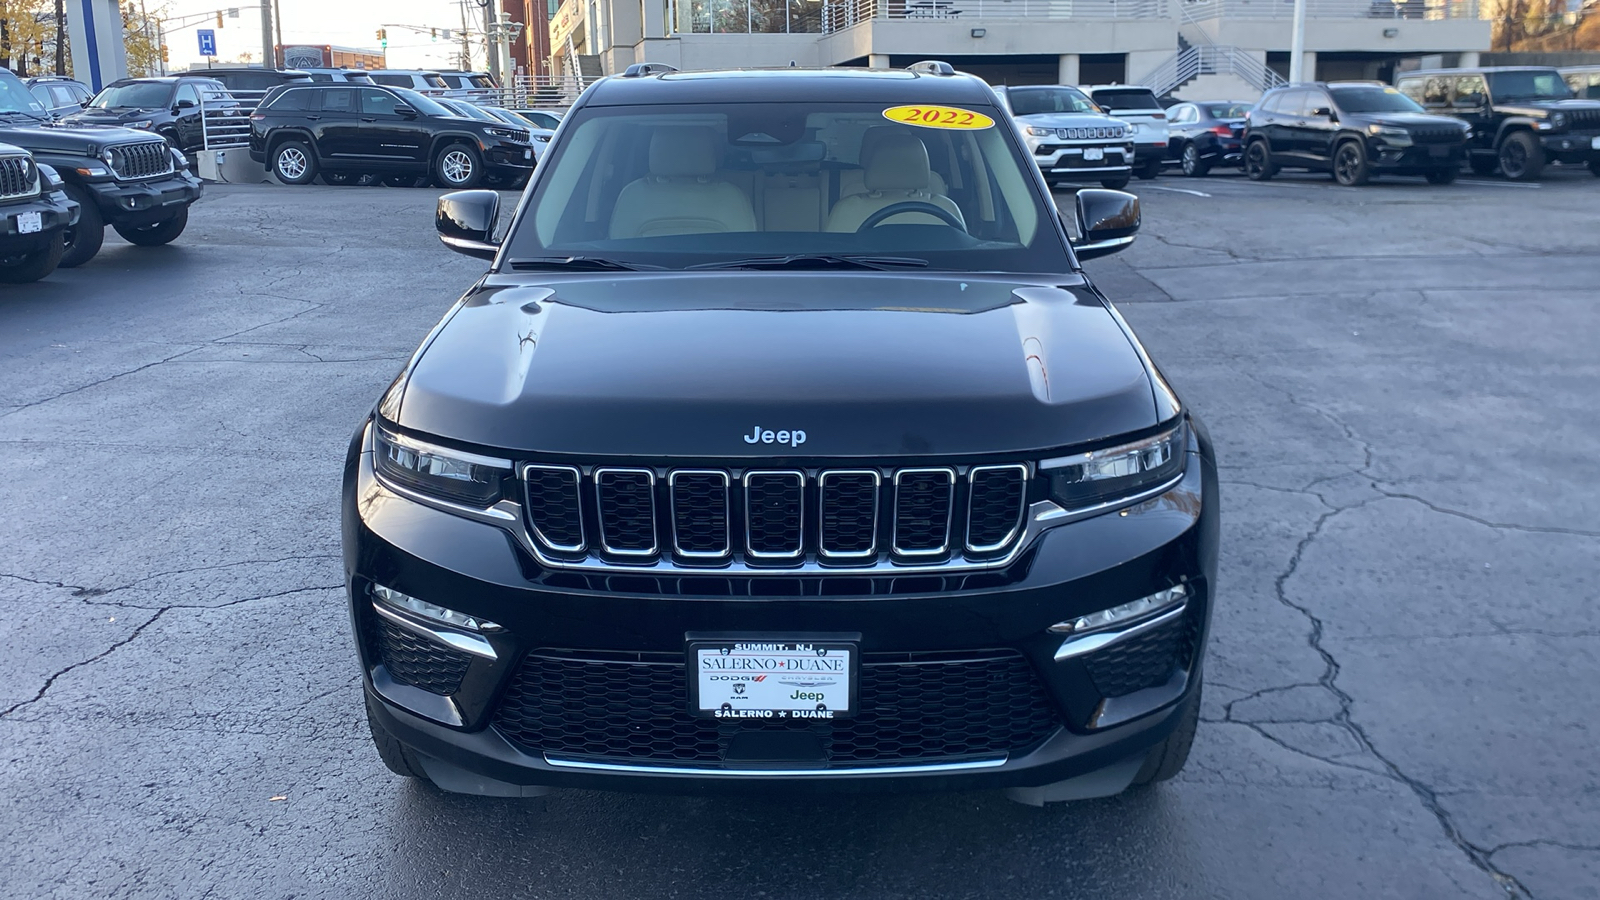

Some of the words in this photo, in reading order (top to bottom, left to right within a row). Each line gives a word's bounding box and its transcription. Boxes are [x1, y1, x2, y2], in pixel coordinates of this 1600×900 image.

[201, 35, 213, 48] H
[903, 109, 975, 125] 2022
[743, 425, 807, 447] Jeep
[795, 643, 813, 651] NJ
[702, 657, 777, 670] SALERNO
[787, 659, 844, 671] DUANE
[789, 689, 825, 702] Jeep
[714, 709, 774, 718] SALERNO
[792, 710, 834, 718] DUANE
